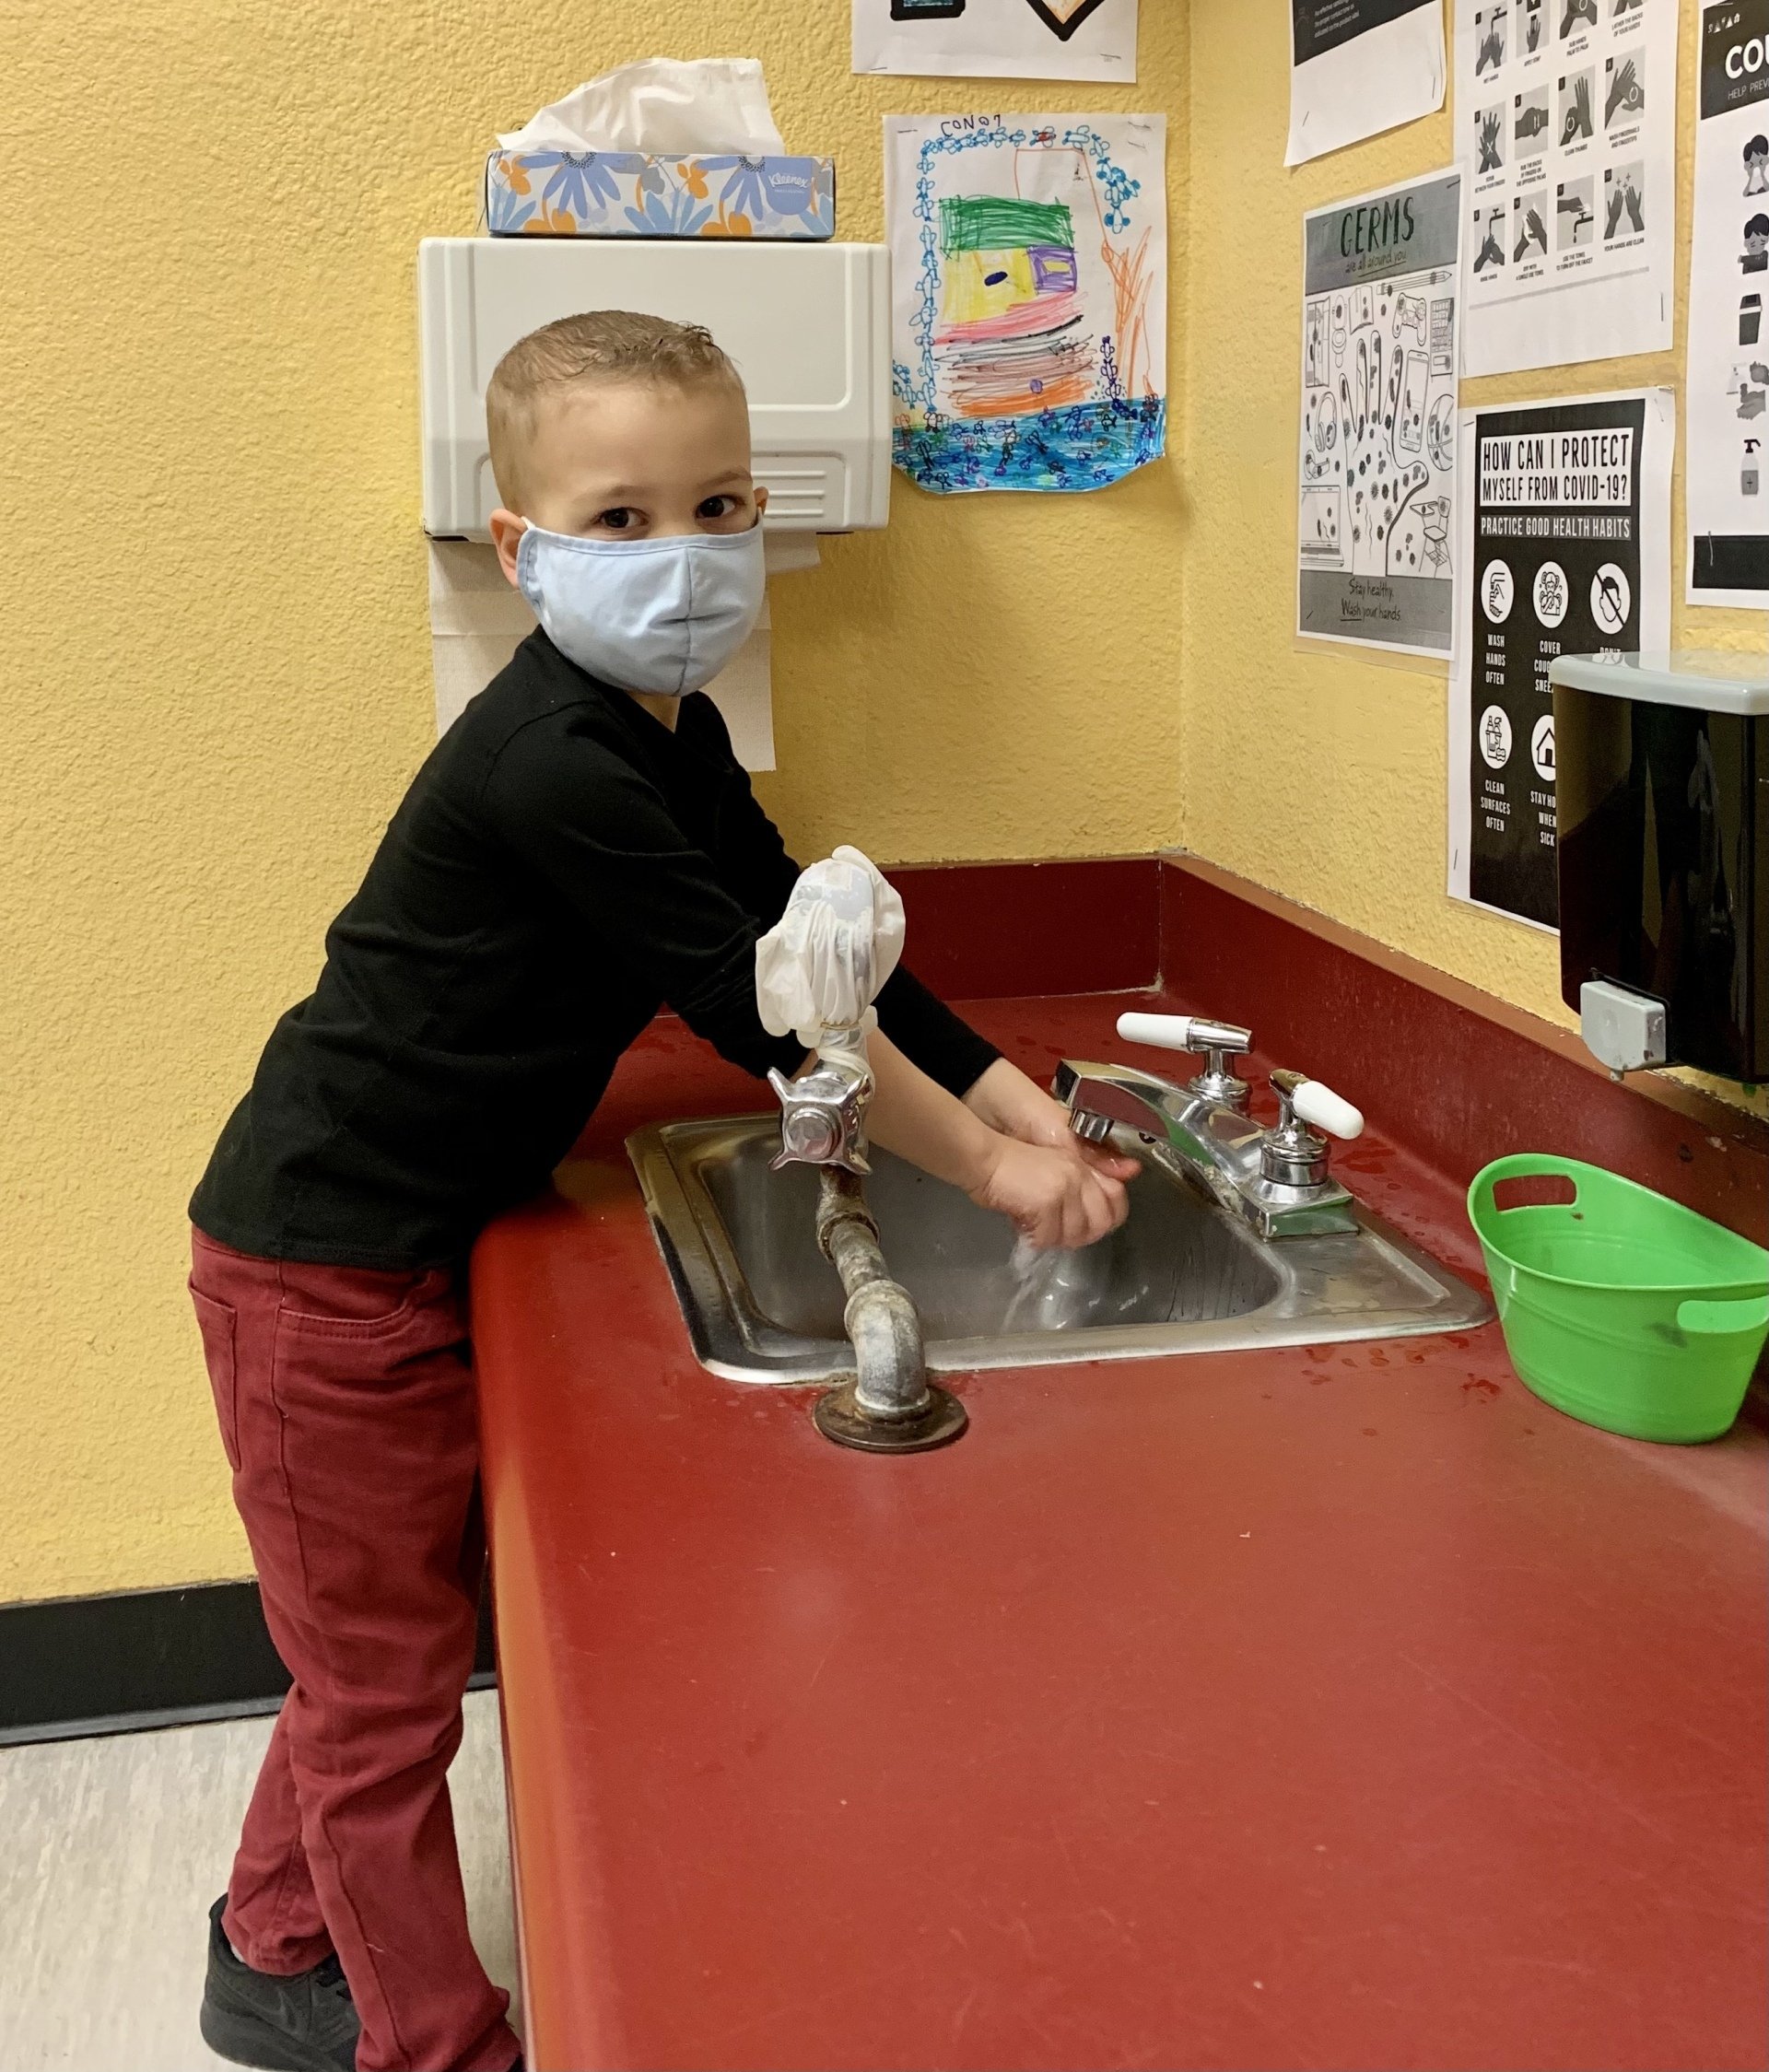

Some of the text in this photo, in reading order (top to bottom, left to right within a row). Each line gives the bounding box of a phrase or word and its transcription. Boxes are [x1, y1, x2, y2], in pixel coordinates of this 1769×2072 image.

[1728, 85, 1747, 100] HELP
[767, 172, 808, 188] Kleenex
[1341, 197, 1414, 257] GERMS
[1614, 241, 1625, 250] HANDS
[1367, 248, 1391, 268] around
[1394, 251, 1406, 263] you
[1483, 435, 1629, 472] HOW CAN I PROTECT
[1482, 474, 1627, 501] MYSELF FROM COVID-19?
[1481, 517, 1630, 537] PRACTICE GOOD HEALTH HABITS
[1349, 577, 1365, 599] Stay
[1341, 598, 1361, 615] Wash
[1363, 606, 1377, 622] your
[1488, 634, 1505, 647] WASH
[1540, 640, 1561, 654] COVER
[1486, 652, 1505, 667] HANDS
[1486, 671, 1504, 685] OFTEN
[1535, 679, 1553, 693] SNEE
[1485, 779, 1505, 795] CLEAN
[1481, 796, 1510, 814] SURFACES
[1530, 790, 1556, 808] STAY HO
[1486, 816, 1504, 832] OFTEN
[1539, 812, 1557, 828] WHEN
[1541, 831, 1555, 847] SICK
